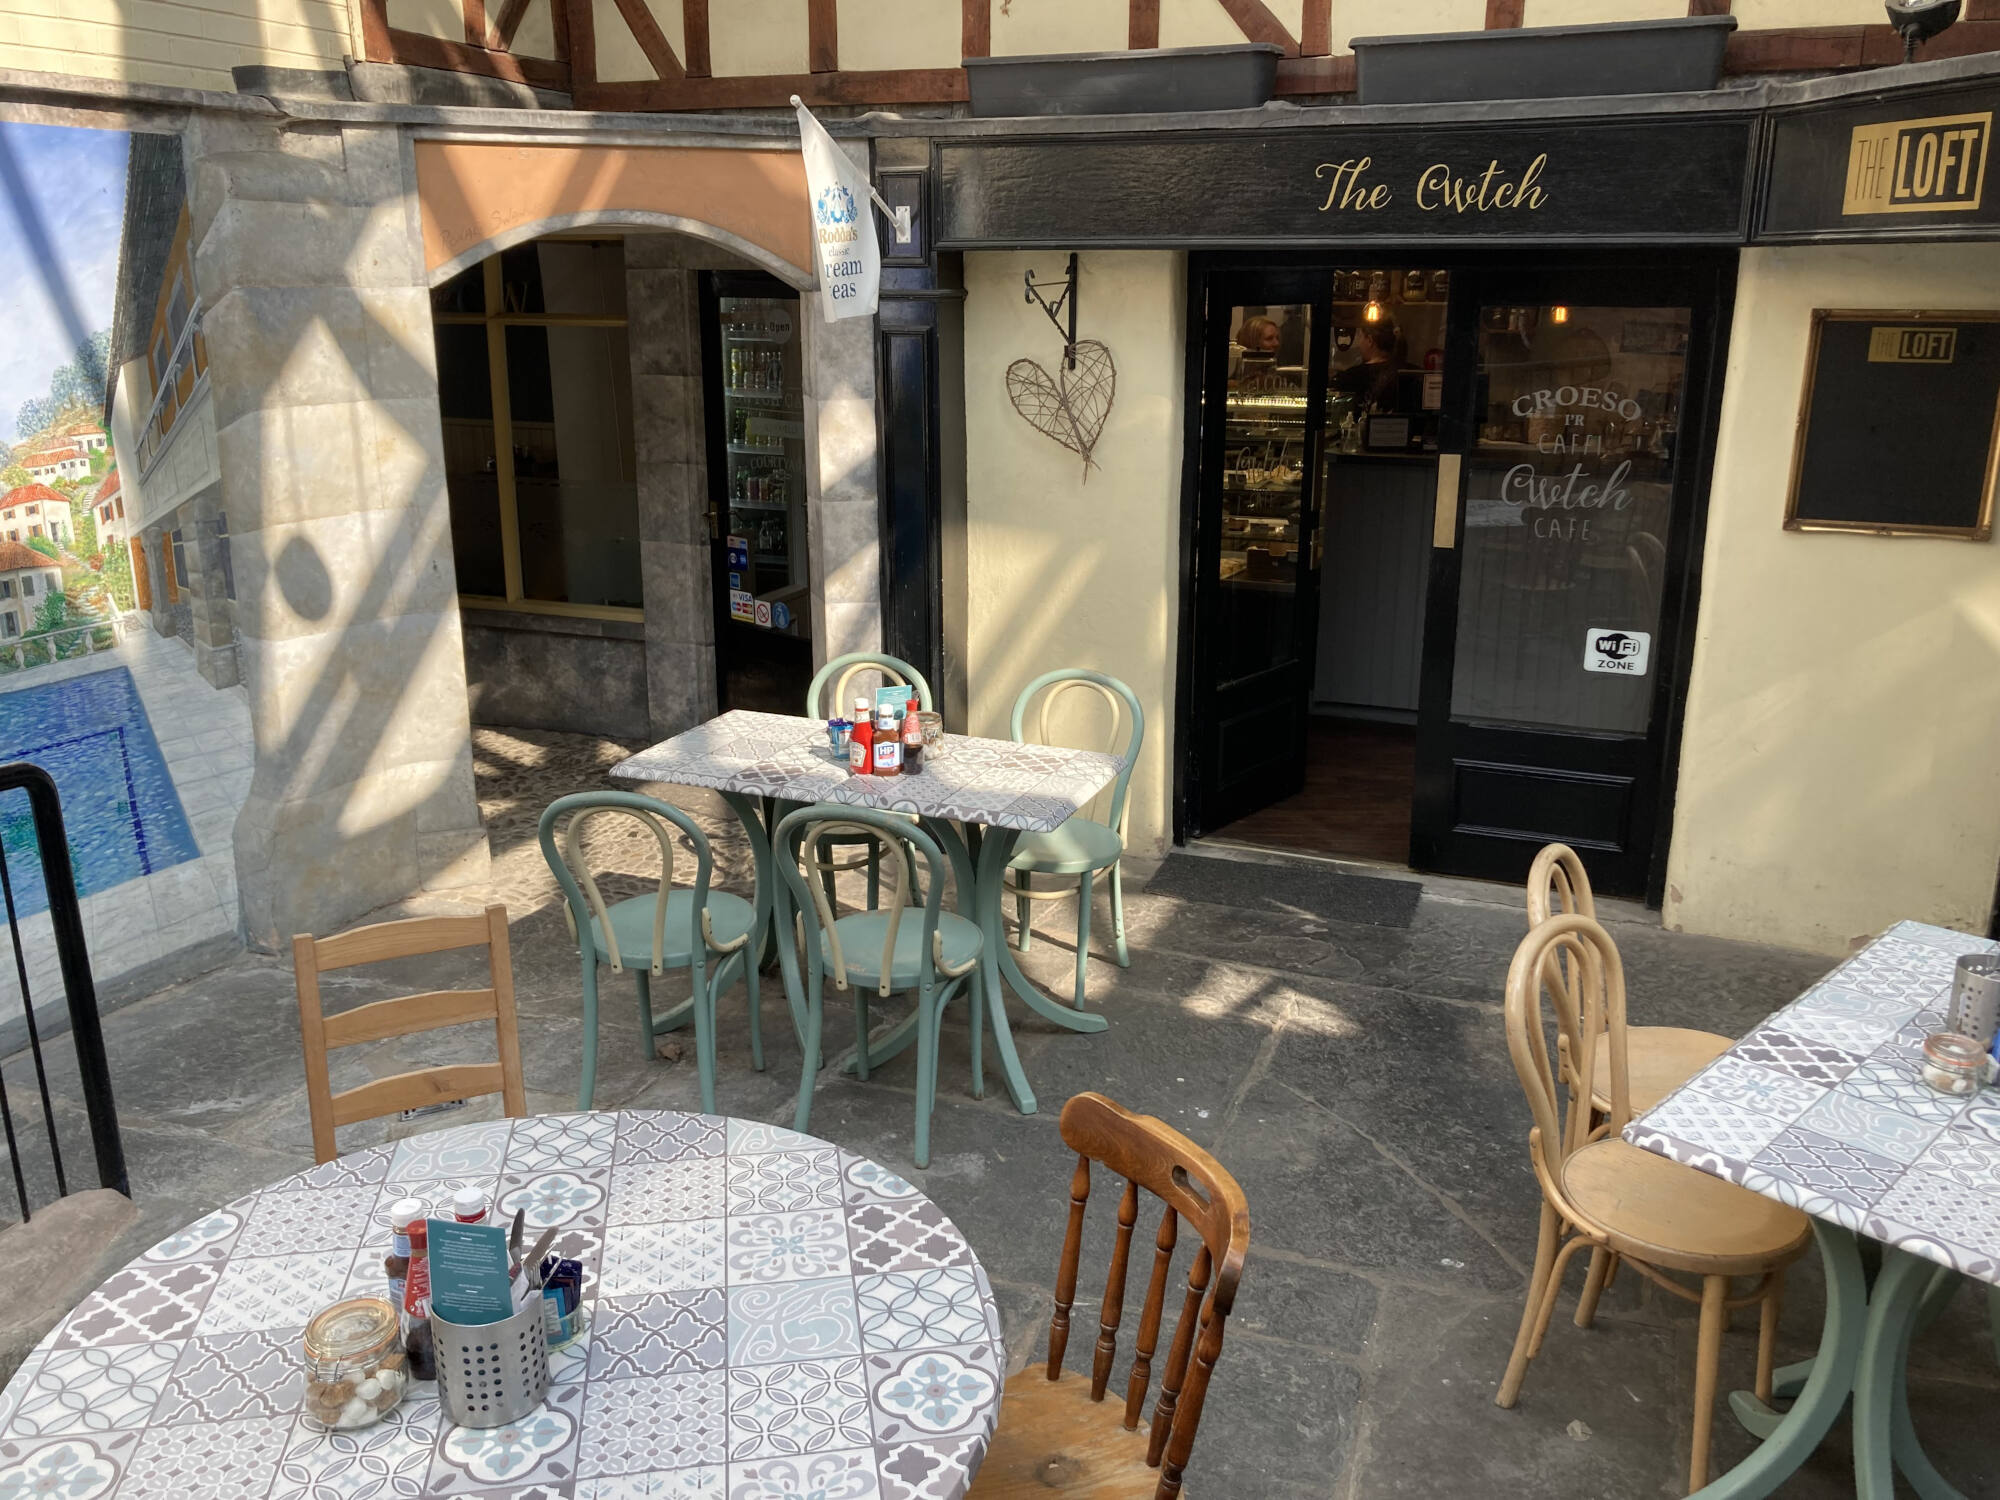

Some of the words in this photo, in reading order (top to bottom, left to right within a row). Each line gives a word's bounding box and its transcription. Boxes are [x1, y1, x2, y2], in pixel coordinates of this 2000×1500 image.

[1854, 138, 1889, 200] THE
[1894, 128, 1979, 198] LOFT
[1315, 156, 1393, 212] The
[1416, 152, 1549, 214] Cwtch
[819, 226, 859, 244] Rodda's
[825, 259, 864, 279] ream
[830, 282, 857, 300] eas
[1901, 332, 1951, 359] LOFT
[1511, 385, 1643, 422] CROESO
[1538, 433, 1602, 456] CAFFI
[1501, 459, 1634, 511] Cwtch
[1534, 517, 1592, 541] CAFE
[1597, 659, 1635, 671] ZONE
[879, 746, 895, 756] HP
